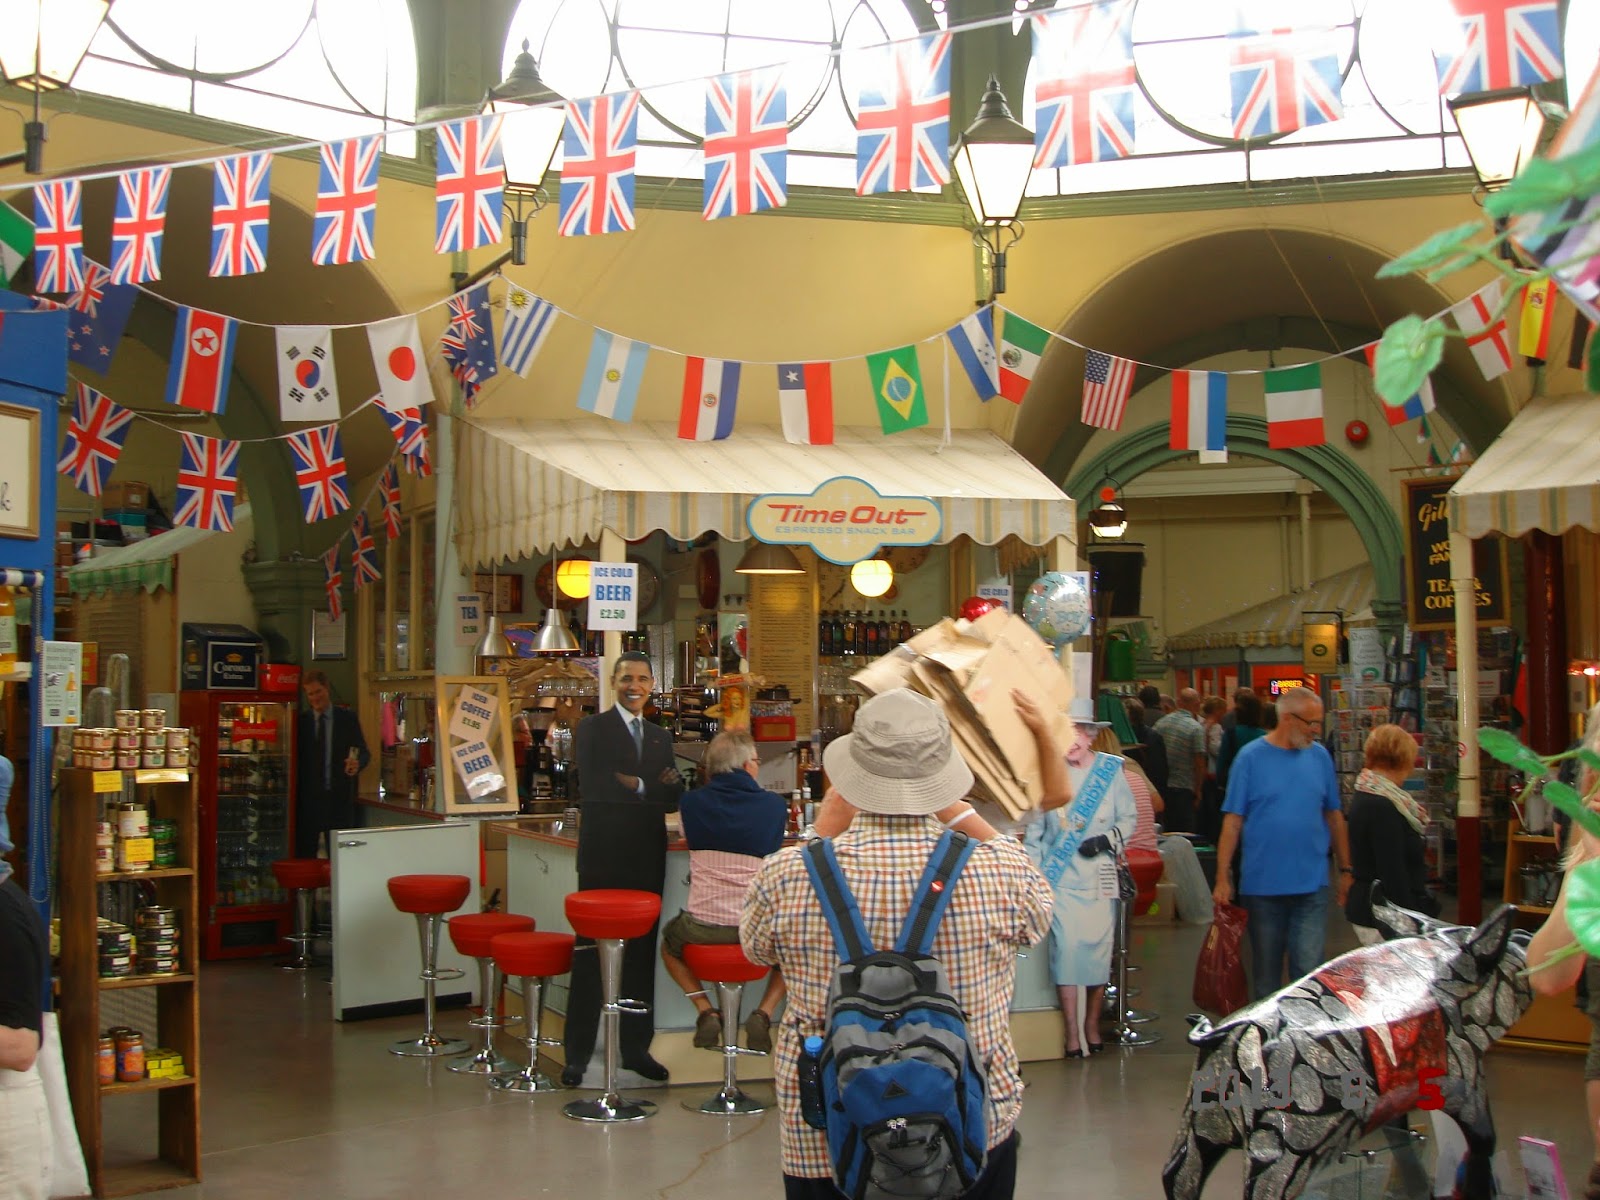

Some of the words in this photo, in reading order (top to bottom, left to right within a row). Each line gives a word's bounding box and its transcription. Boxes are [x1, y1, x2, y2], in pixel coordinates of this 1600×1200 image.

[767, 504, 847, 524] Time
[850, 505, 928, 525] Out
[775, 525, 843, 535] ESPRESSO
[847, 526, 887, 535] SNACK
[891, 527, 916, 536] BAR
[595, 567, 609, 578] ICE
[610, 567, 634, 578] COLD
[595, 584, 632, 601] BEER
[980, 587, 991, 596] ICE
[992, 588, 1009, 597] COLD
[461, 606, 479, 620] TEA
[599, 608, 626, 620] £2.50
[213, 661, 253, 675] Corona
[222, 672, 244, 680] Extra
[472, 691, 488, 704] ICED
[461, 701, 492, 721] COFFEE
[462, 716, 482, 730] £1.95
[456, 748, 469, 758] ICE
[467, 741, 486, 755] COLD
[463, 754, 493, 775] BEER
[1055, 830, 1078, 863] Boy
[1076, 779, 1105, 819] Baby
